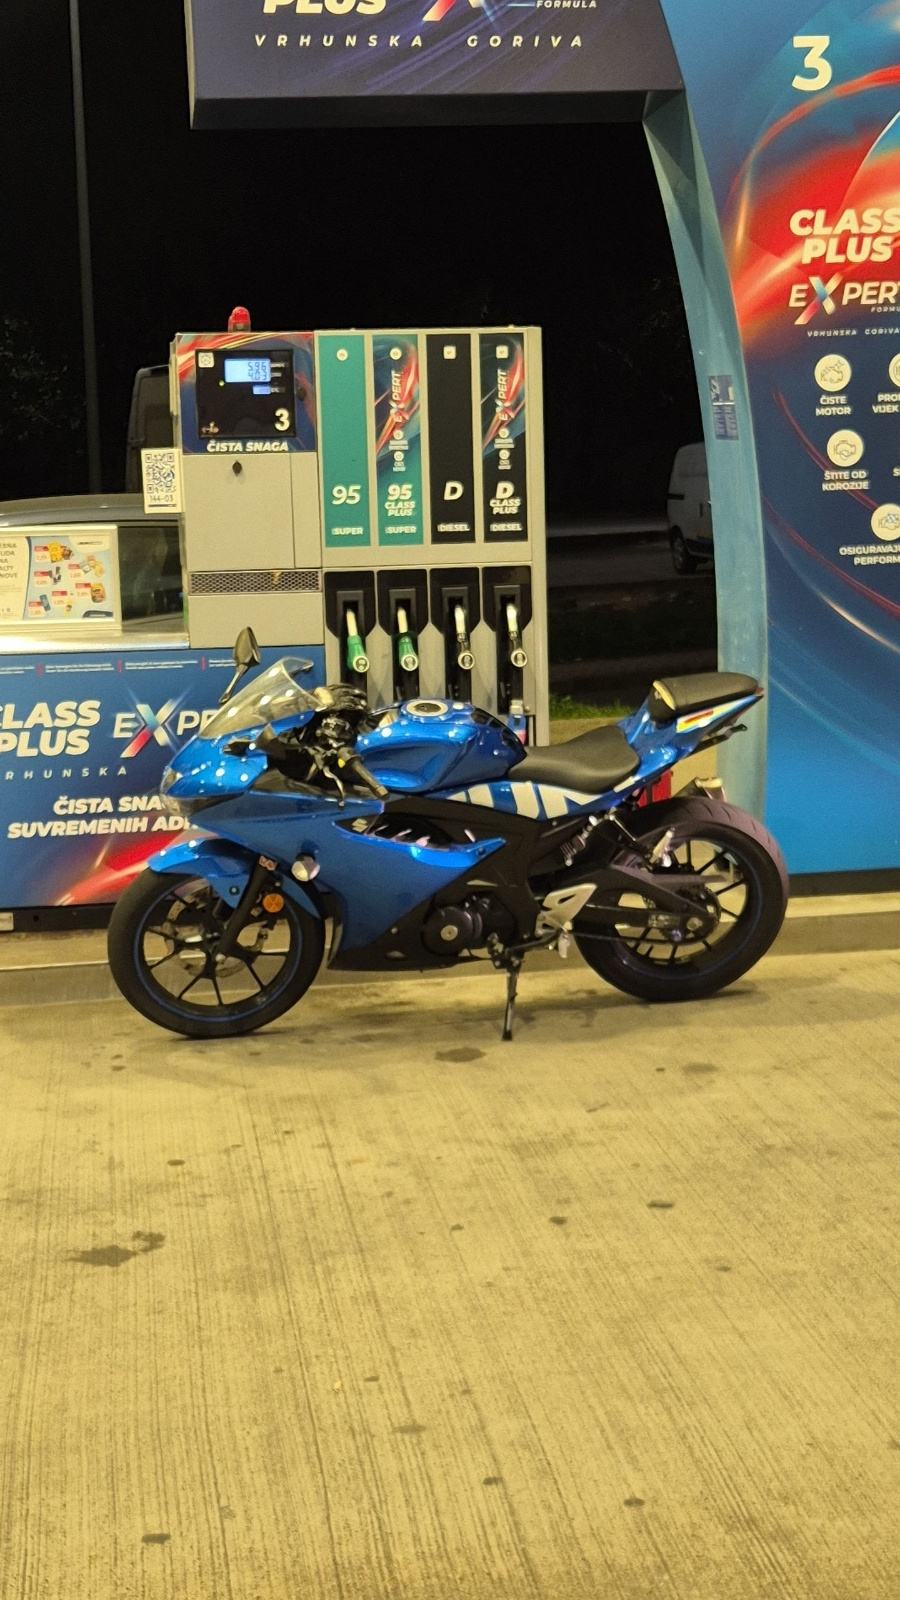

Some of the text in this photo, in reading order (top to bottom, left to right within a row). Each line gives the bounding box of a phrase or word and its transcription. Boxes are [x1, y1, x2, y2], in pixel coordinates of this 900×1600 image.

[536, 0, 597, 8] FORMULA
[255, 34, 582, 47] VRHUNSKA GORIVA
[791, 35, 833, 91] 3
[789, 208, 900, 235] CLASS
[801, 236, 893, 264] PLUS
[789, 272, 900, 325] EXPER
[274, 408, 290, 431] 3
[816, 406, 852, 416] MOTOR
[207, 439, 289, 452] ČISTA SNAGA
[851, 470, 867, 479] OD
[331, 485, 361, 505] 95
[387, 484, 412, 500] 95
[444, 481, 464, 500] D
[496, 481, 515, 499] D
[384, 501, 416, 510] CLASS
[489, 498, 521, 507] CLASS
[493, 506, 519, 515] PLUS
[332, 526, 363, 535] SUPER
[385, 525, 417, 534] SUPER
[0, 700, 101, 730] LASS
[0, 729, 90, 757] PLUS
[53, 795, 166, 815] ČISTA SNA
[7, 817, 148, 838] SUVREMENIH
